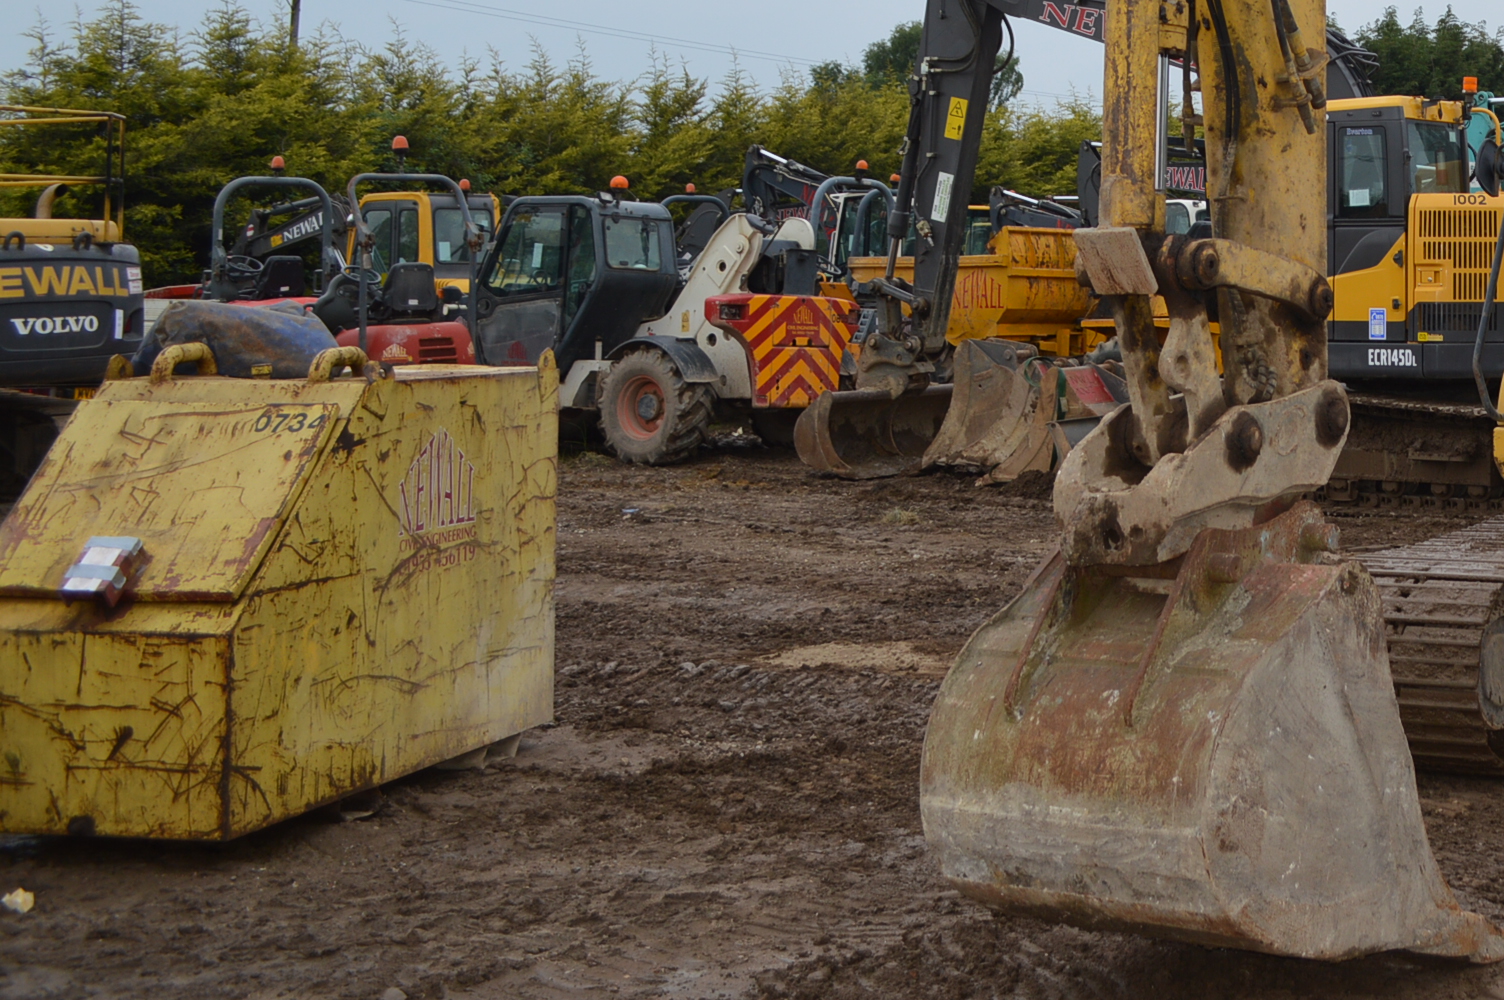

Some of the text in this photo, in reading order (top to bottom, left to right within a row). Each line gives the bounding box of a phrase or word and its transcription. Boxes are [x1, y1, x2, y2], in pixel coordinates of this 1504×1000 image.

[1453, 195, 1487, 205] 1002
[0, 266, 129, 298] EWALL
[953, 269, 1004, 309] NEWALL
[10, 315, 99, 335] VOLVO
[254, 412, 325, 432] 0734
[398, 426, 477, 538] NEWALL
[400, 534, 421, 552] CIVI
